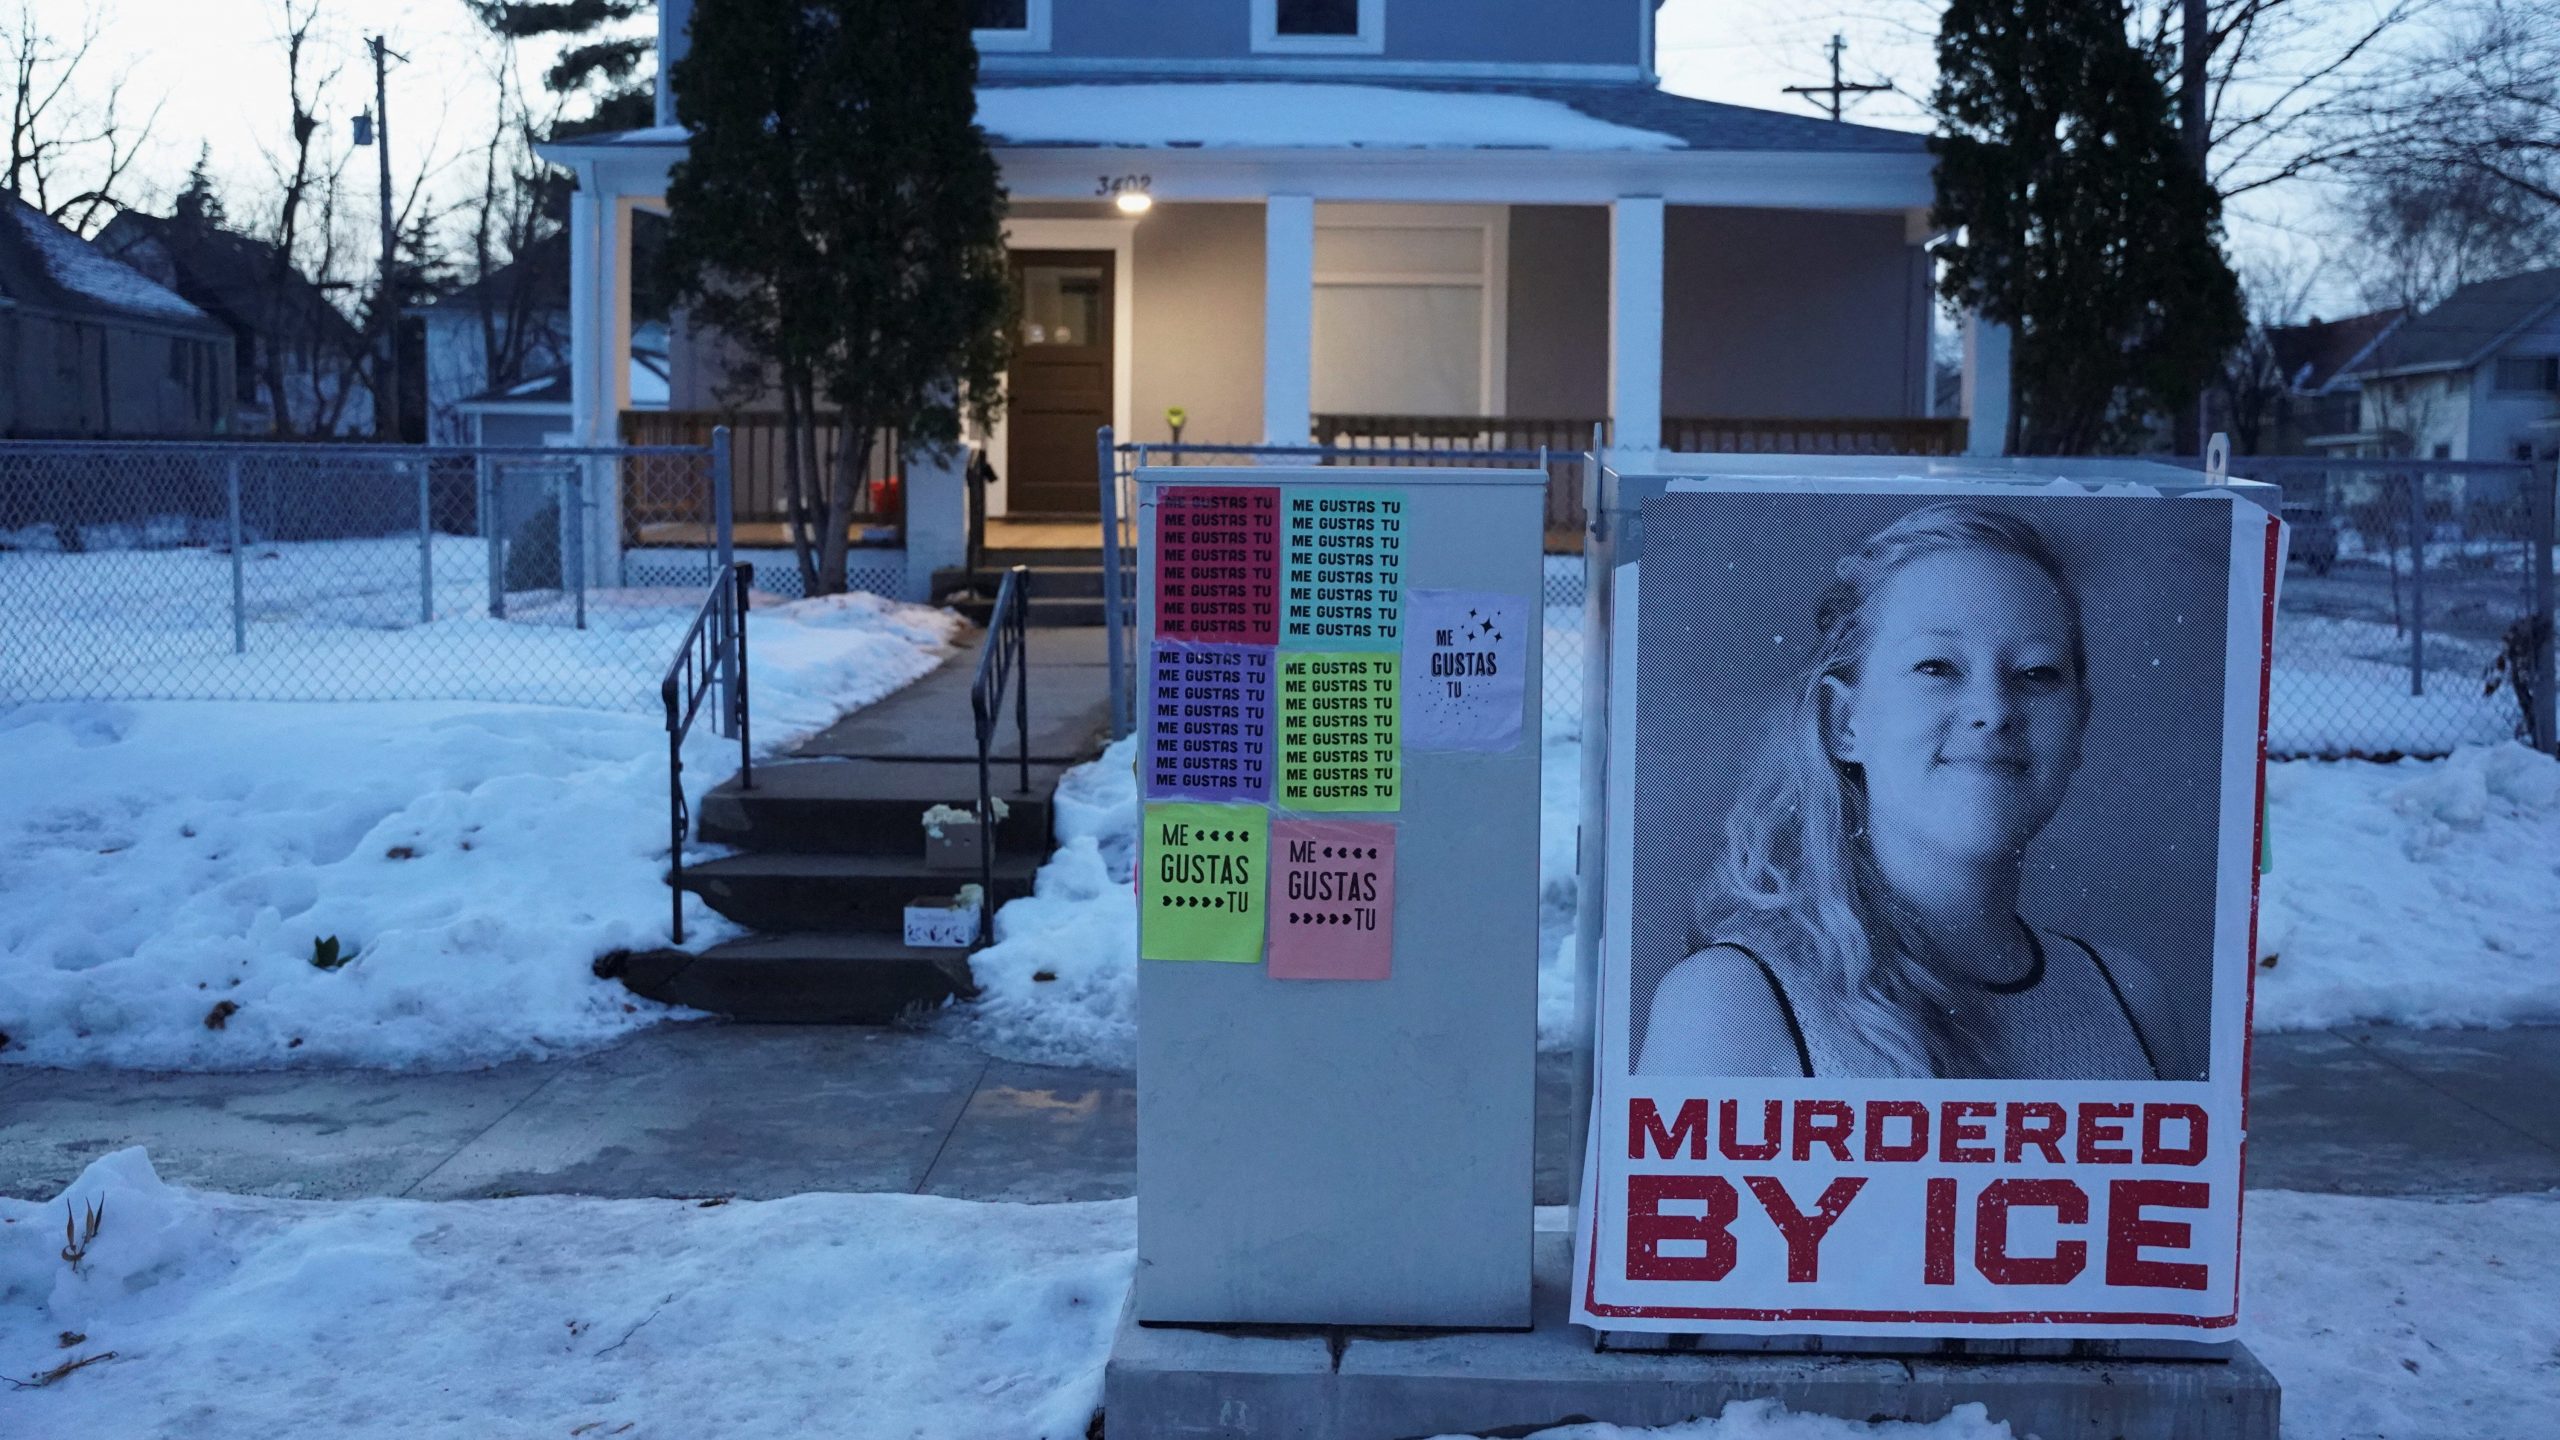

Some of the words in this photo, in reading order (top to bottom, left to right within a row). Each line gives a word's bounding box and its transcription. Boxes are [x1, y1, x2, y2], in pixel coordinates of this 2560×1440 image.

[1165, 496, 1186, 508] ME
[1192, 496, 1247, 509] GUSTAS
[1253, 497, 1272, 509] TU
[1293, 499, 1313, 511] ME
[1320, 500, 1375, 513] GUSTAS
[1382, 502, 1400, 513] TU
[1165, 514, 1185, 526] ME
[1192, 514, 1247, 526] GUSTAS
[1253, 514, 1272, 526] TU
[1293, 517, 1313, 529] ME
[1319, 518, 1374, 530] GUSTAS
[1381, 519, 1399, 531] TU
[1165, 532, 1185, 544] ME
[1192, 531, 1247, 544] GUSTAS
[1253, 532, 1272, 544] TU
[1292, 535, 1312, 546] ME
[1319, 535, 1373, 548] GUSTAS
[1381, 537, 1398, 549] TU
[1165, 549, 1185, 561] ME
[1192, 549, 1246, 561] GUSTAS
[1253, 550, 1272, 562] TU
[1292, 553, 1312, 564] ME
[1319, 553, 1373, 566] GUSTAS
[1380, 555, 1398, 567] TU
[1165, 567, 1185, 579] ME
[1191, 567, 1246, 579] GUSTAS
[1253, 568, 1271, 579] TU
[1291, 570, 1311, 582] ME
[1318, 571, 1373, 583] GUSTAS
[1380, 572, 1397, 584] TU
[1165, 584, 1185, 596] ME
[1191, 584, 1246, 597] GUSTAS
[1253, 585, 1271, 597] TU
[1291, 588, 1311, 599] ME
[1318, 588, 1372, 601] GUSTAS
[1379, 590, 1397, 602] TU
[1164, 602, 1184, 614] ME
[1191, 602, 1246, 614] GUSTAS
[1252, 603, 1271, 615] TU
[1291, 606, 1310, 617] ME
[1317, 606, 1372, 619] GUSTAS
[1378, 608, 1396, 620] TU
[1164, 620, 1185, 632] ME
[1191, 620, 1246, 632] GUSTAS
[1252, 620, 1271, 632] TU
[1290, 623, 1310, 634] ME
[1316, 624, 1371, 636] GUSTAS
[1378, 626, 1396, 637] TU
[1435, 629, 1454, 646] ME
[1160, 652, 1179, 663] ME
[1186, 652, 1241, 665] GUSTAS
[1248, 654, 1266, 666] TU
[1431, 652, 1497, 677] GUSTAS
[1286, 663, 1306, 674] ME
[1312, 662, 1367, 674] GUSTAS
[1373, 662, 1391, 674] TU
[1159, 669, 1179, 681] ME
[1186, 670, 1240, 683] GUSTAS
[1247, 672, 1265, 684] TU
[1286, 681, 1306, 692] ME
[1312, 680, 1367, 692] GUSTAS
[1374, 680, 1392, 691] TU
[1446, 681, 1462, 698] TU
[1159, 687, 1179, 698] ME
[1185, 687, 1239, 700] GUSTAS
[1246, 689, 1264, 701] TU
[1286, 698, 1306, 710] ME
[1313, 698, 1367, 709] GUSTAS
[1374, 698, 1392, 709] TU
[1158, 704, 1178, 716] ME
[1185, 705, 1239, 717] GUSTAS
[1246, 707, 1264, 719] TU
[1287, 716, 1306, 727] ME
[1313, 715, 1367, 727] GUSTAS
[1374, 715, 1392, 726] TU
[1158, 722, 1178, 734] ME
[1184, 722, 1238, 735] GUSTAS
[1245, 724, 1263, 736] TU
[1287, 734, 1306, 745] ME
[1313, 733, 1367, 745] GUSTAS
[1374, 733, 1392, 744] TU
[1157, 739, 1177, 751] ME
[1184, 740, 1238, 753] GUSTAS
[1244, 742, 1262, 754] TU
[1287, 752, 1307, 763] ME
[1313, 751, 1368, 762] GUSTAS
[1374, 750, 1392, 762] TU
[1157, 757, 1177, 769] ME
[1183, 757, 1237, 770] GUSTAS
[1244, 760, 1262, 771] TU
[1157, 774, 1176, 785] ME
[1183, 774, 1237, 787] GUSTAS
[1244, 777, 1261, 788] TU
[1287, 769, 1307, 780] ME
[1313, 768, 1368, 780] GUSTAS
[1374, 768, 1392, 779] TU
[1287, 786, 1307, 797] ME
[1313, 785, 1367, 797] GUSTAS
[1374, 785, 1392, 796] TU
[1162, 824, 1188, 846] ME
[1290, 840, 1316, 863] ME
[1161, 854, 1249, 884] GUSTAS
[1288, 871, 1377, 901] GUSTAS
[1227, 891, 1248, 912] TU
[1355, 908, 1376, 930] TU
[1628, 1097, 2208, 1166] MURDERED
[1626, 1174, 1868, 1282] BY
[1924, 1177, 2210, 1290] ICE
